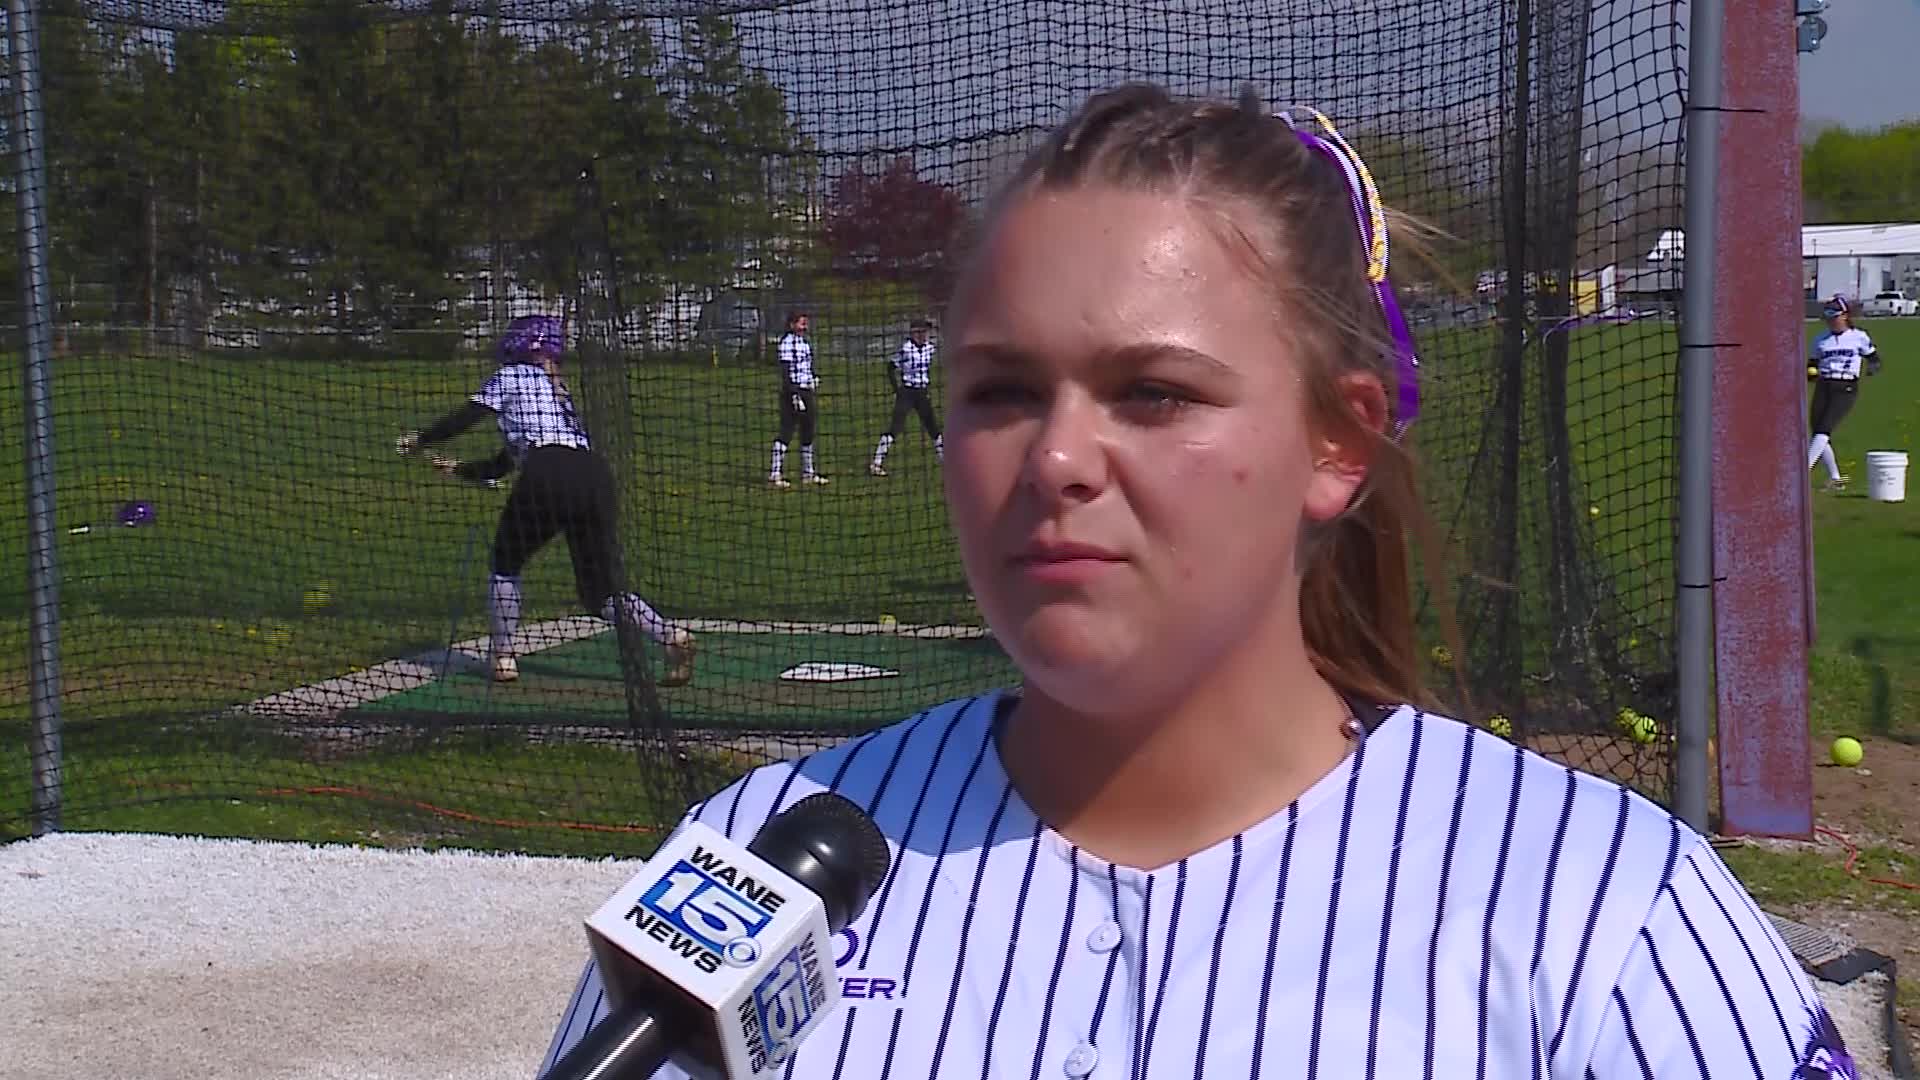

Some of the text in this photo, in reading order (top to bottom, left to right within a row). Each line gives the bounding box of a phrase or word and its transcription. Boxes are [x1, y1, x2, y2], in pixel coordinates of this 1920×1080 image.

[653, 870, 766, 948] 15
[690, 846, 786, 914] WANE
[624, 904, 722, 974] NEWS
[799, 931, 826, 1013] WANE
[760, 958, 806, 1044] 15
[838, 977, 897, 1000] ER
[737, 995, 767, 1075] NEWS
